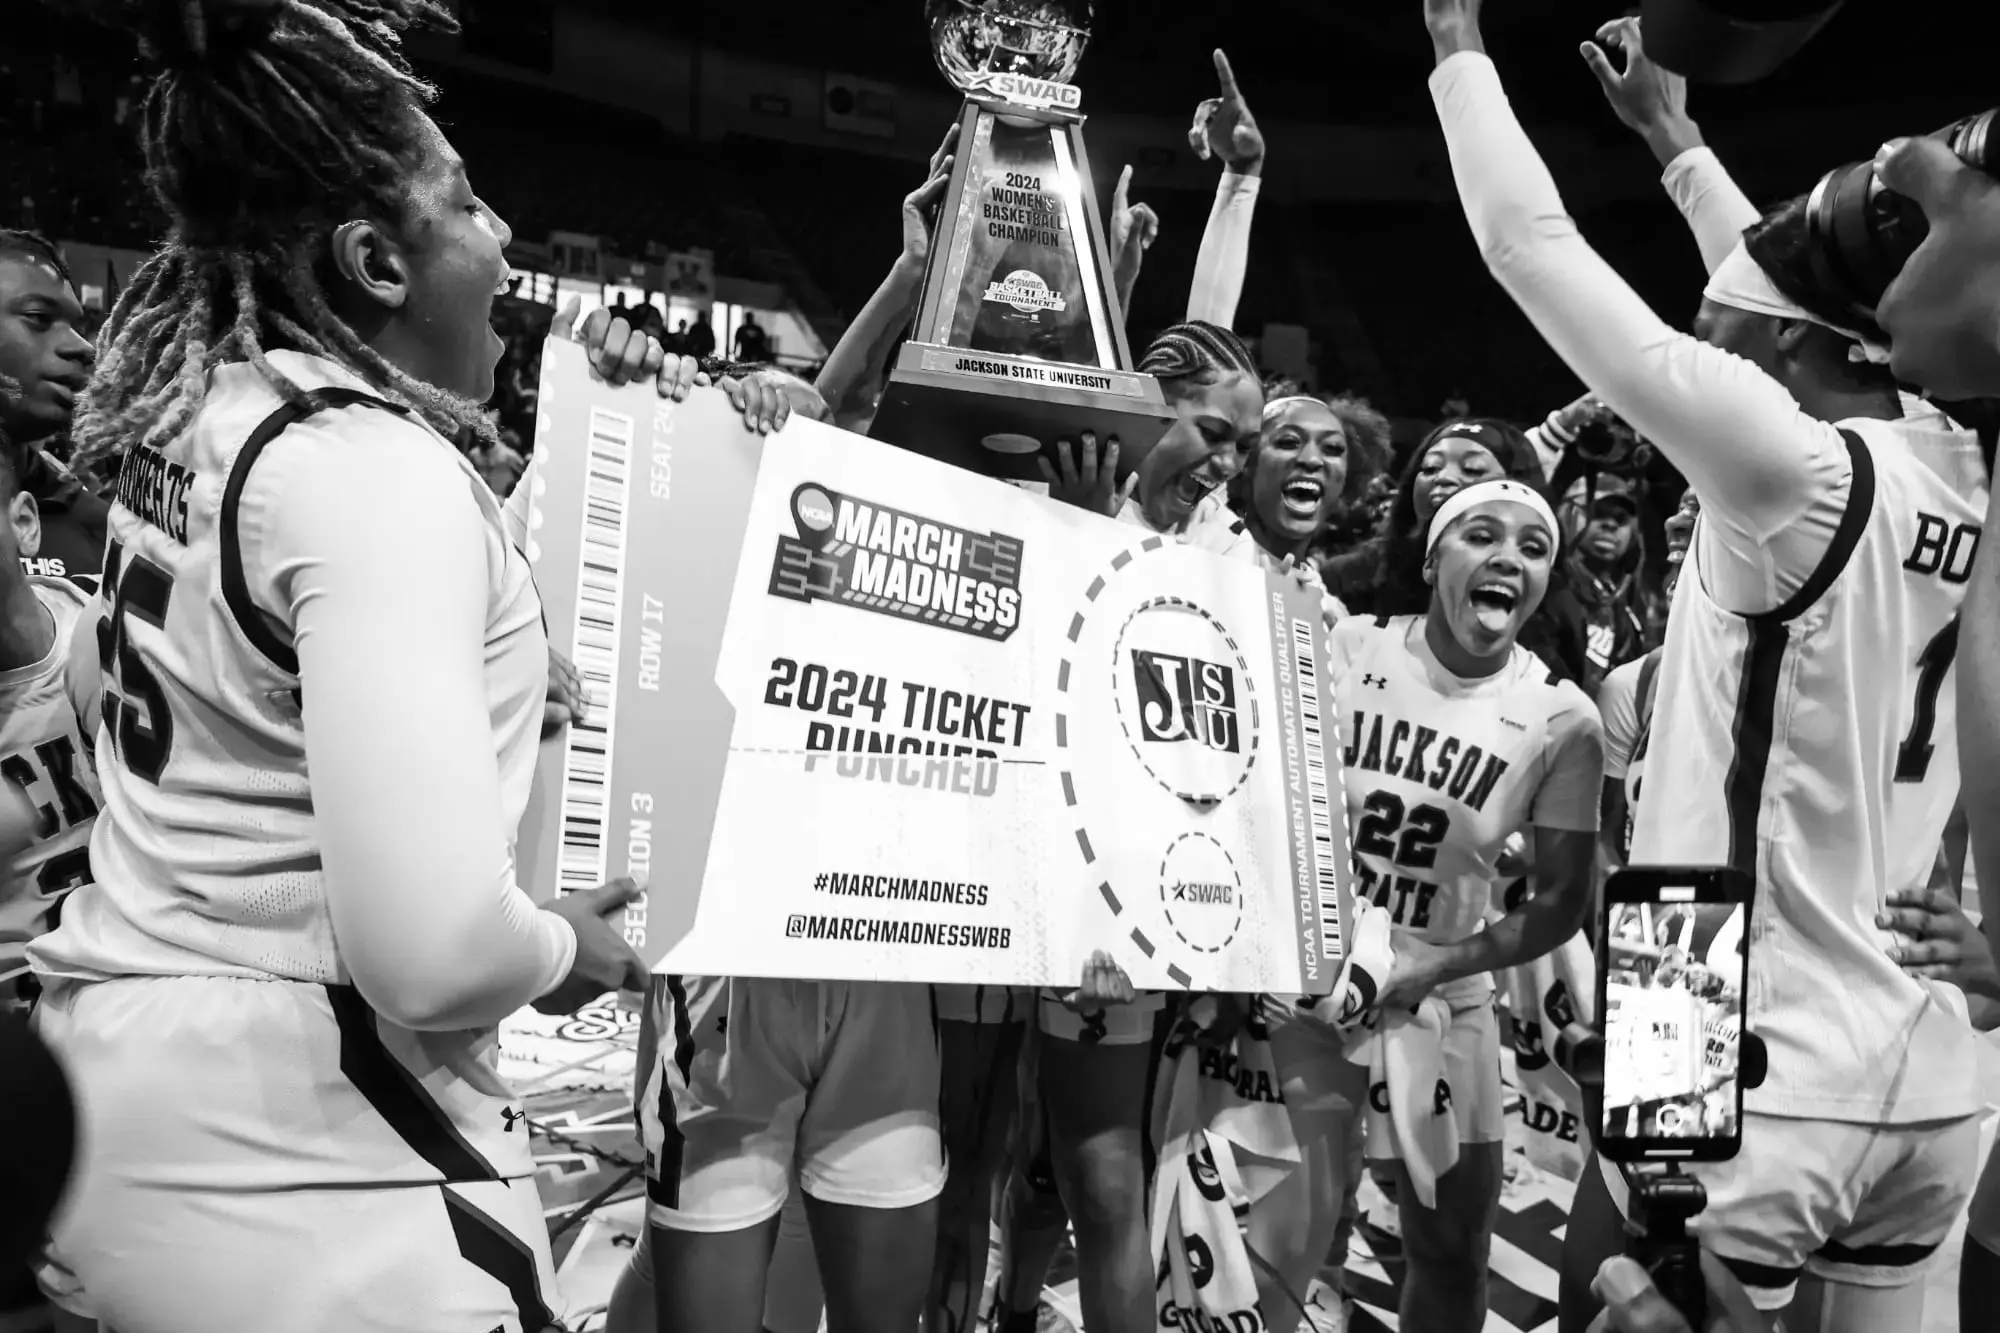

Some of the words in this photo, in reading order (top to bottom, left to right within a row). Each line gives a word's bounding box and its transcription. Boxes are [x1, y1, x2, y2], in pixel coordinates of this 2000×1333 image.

[1000, 77, 1077, 104] SWAC
[992, 187, 1055, 211] WOMEN'S
[1006, 172, 1041, 191] 2024
[984, 204, 1064, 230] BASKETBALL
[989, 222, 1059, 247] CHAMPION
[990, 281, 1062, 300] BASKETBALL
[994, 293, 1056, 308] TOURNAMENT
[955, 358, 1008, 376] JACKSON
[1012, 366, 1045, 380] STATE
[1049, 371, 1111, 389] UNIVERSITY
[650, 434, 673, 499] SEAT
[835, 499, 963, 571] MARCH
[1902, 511, 1982, 584] BO
[643, 592, 664, 620] 17
[851, 548, 1019, 628] MADNESS
[638, 625, 662, 692] ROW
[1272, 591, 1292, 684] QUALIFIER
[764, 657, 887, 722] 2024
[902, 681, 1031, 746] TICKET
[804, 721, 999, 798] PUNCHED
[1282, 687, 1303, 792] AUTOMATIC
[1343, 710, 1509, 813] JACKSON
[631, 792, 654, 813] 3
[1355, 789, 1450, 869] 22
[624, 818, 652, 948] SECION
[814, 872, 989, 906] #MARCHMADNESS
[1291, 797, 1313, 925] TOURNAMENT
[1188, 883, 1232, 904] SWAC
[1352, 860, 1439, 929] TATE
[786, 914, 1011, 949] @MARCHMADNESSWBB
[1303, 928, 1318, 980] NCAA
